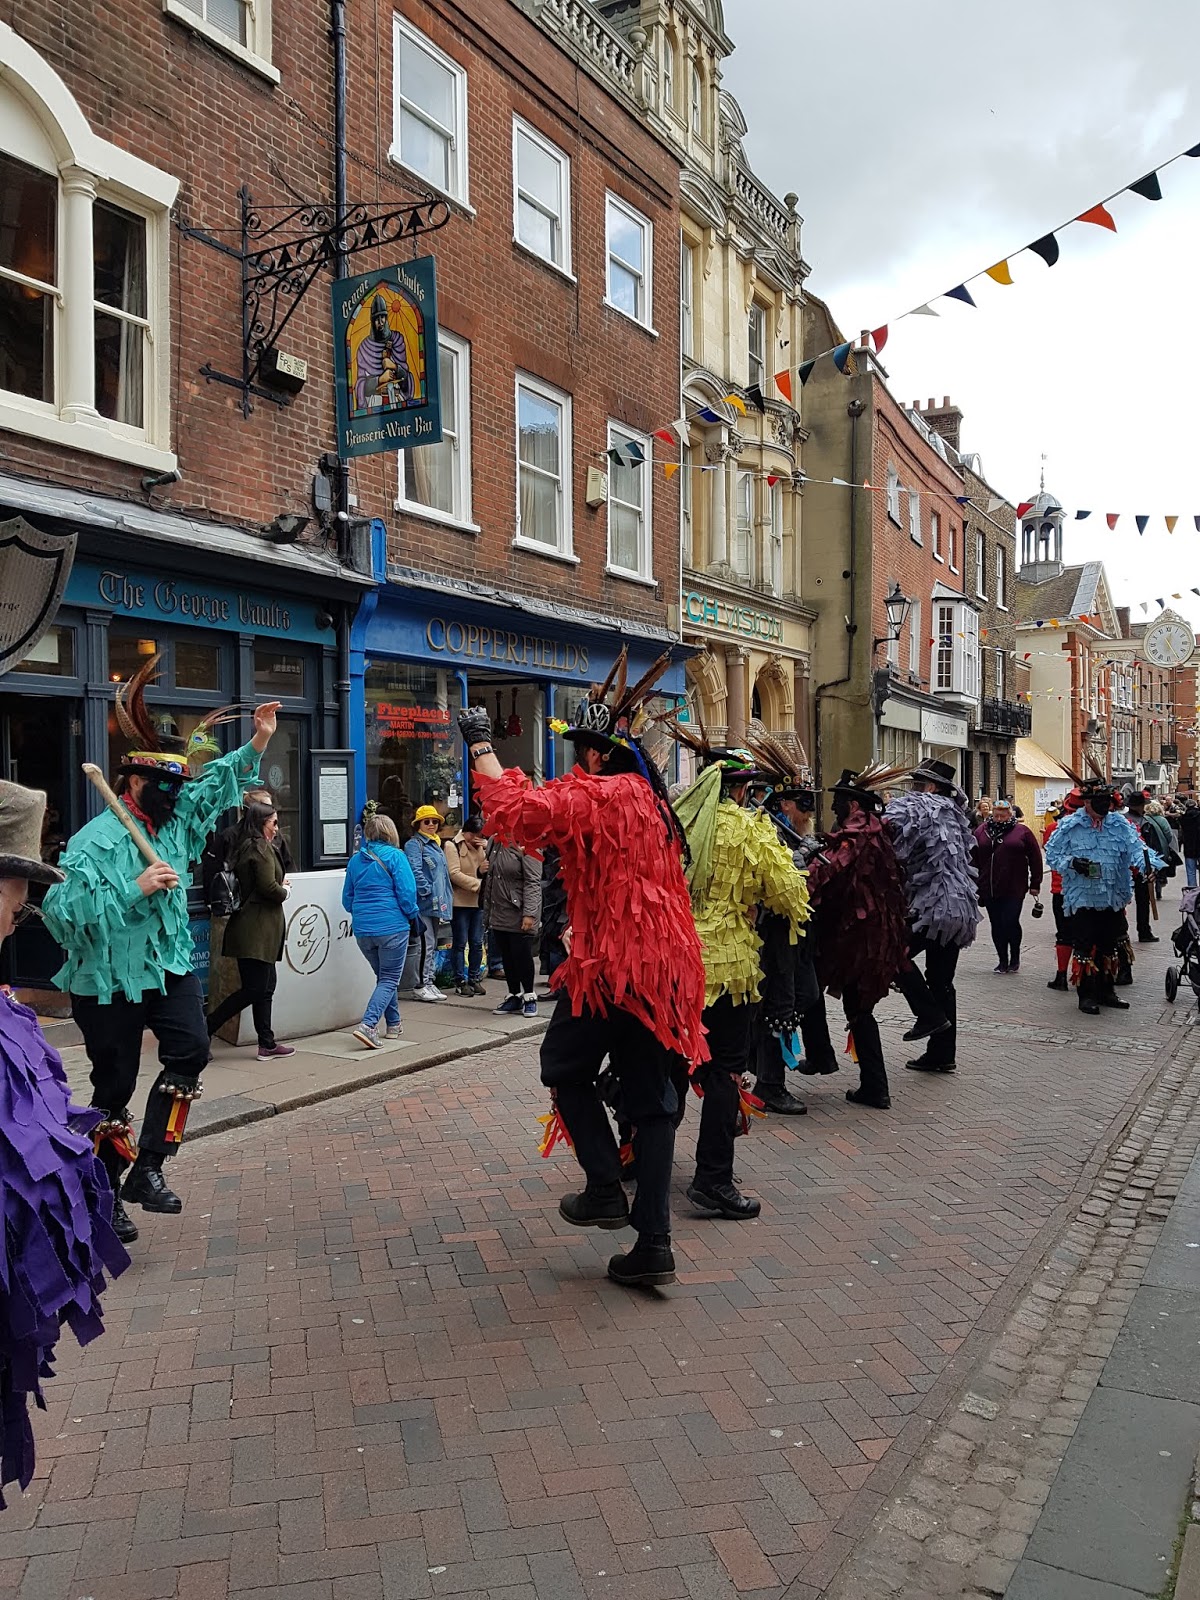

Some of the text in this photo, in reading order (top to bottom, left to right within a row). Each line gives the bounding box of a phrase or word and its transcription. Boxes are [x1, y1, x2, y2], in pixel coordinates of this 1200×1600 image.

[342, 267, 425, 318] George Vaults
[414, 416, 433, 436] Bar
[99, 570, 291, 630] The George Vaults
[723, 601, 784, 643] VISION
[426, 617, 589, 674] COPPERFIELD'S
[377, 702, 451, 720] Fireplaces
[390, 720, 414, 730] MARTIN
